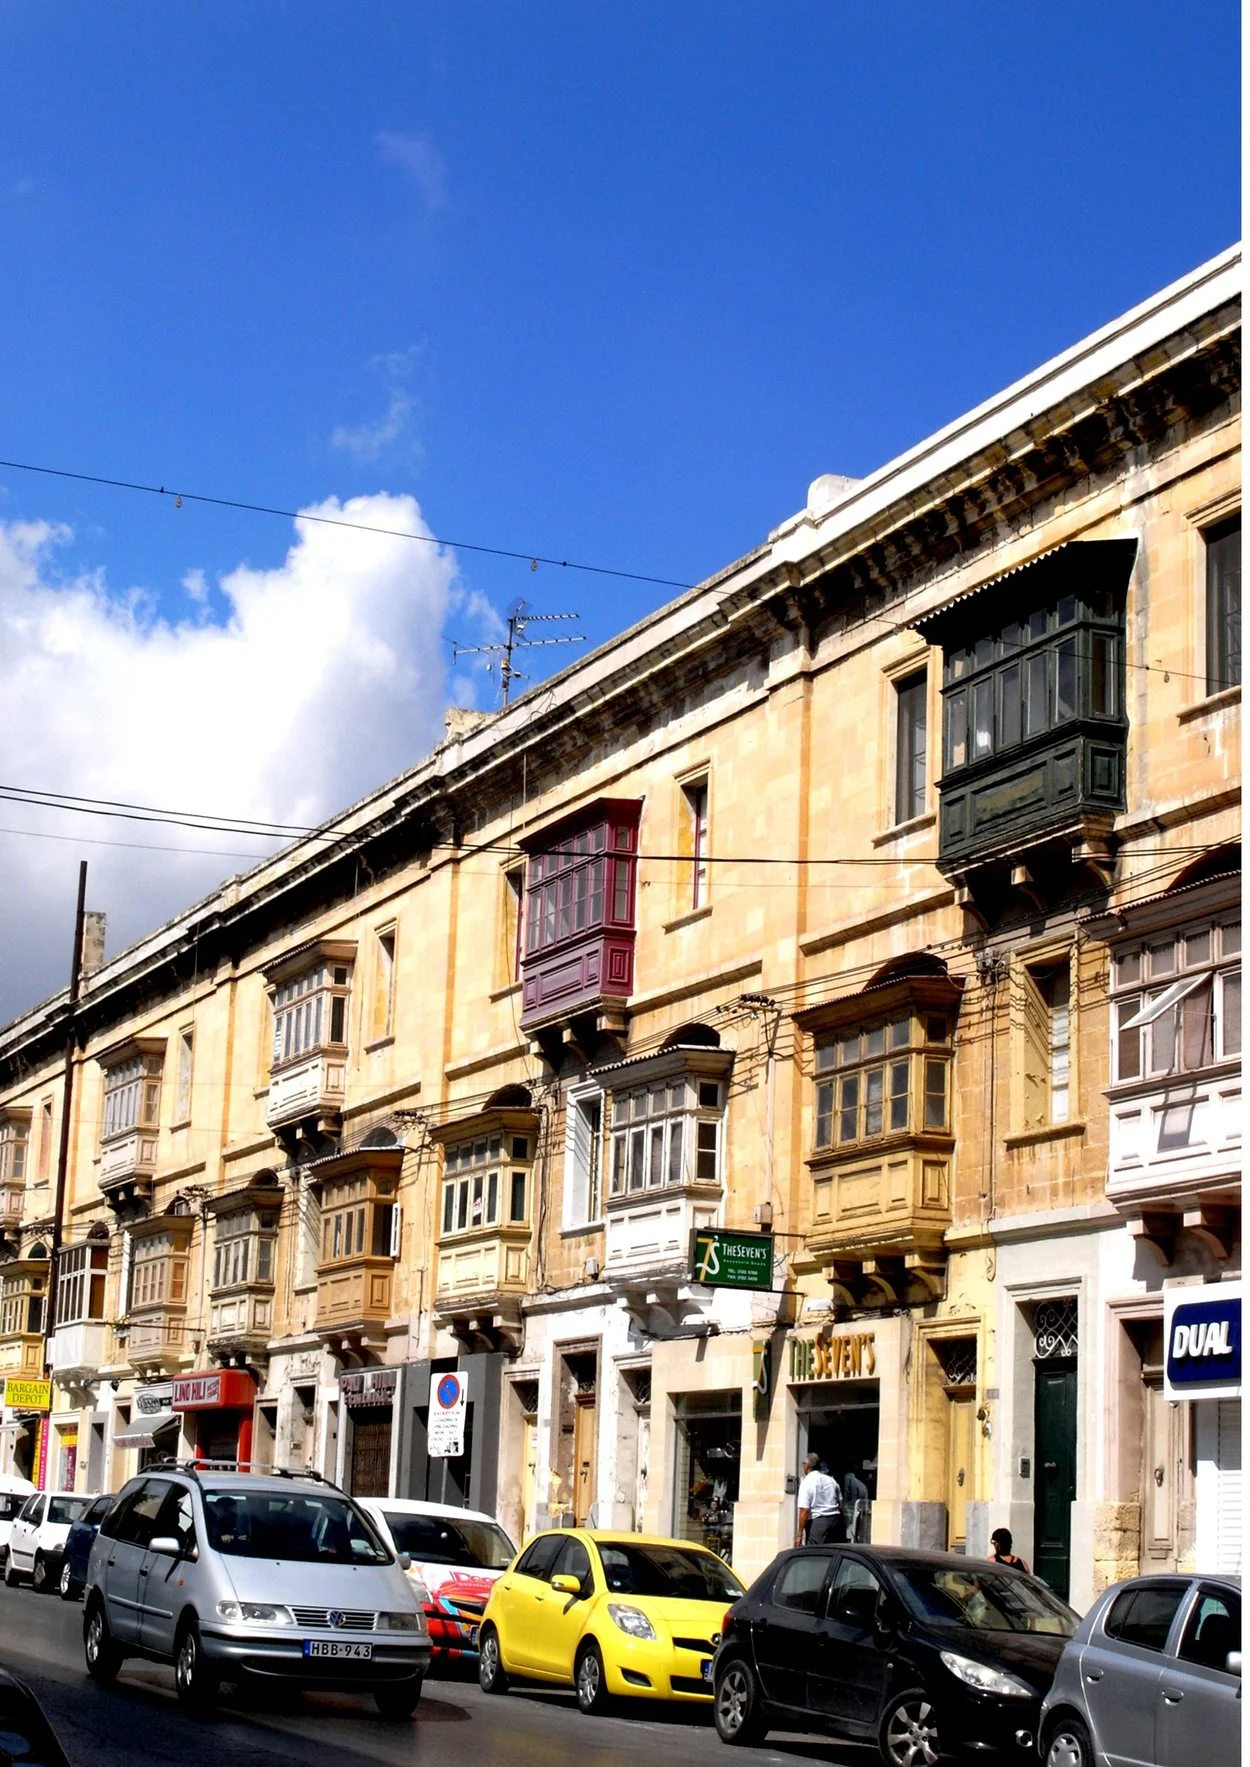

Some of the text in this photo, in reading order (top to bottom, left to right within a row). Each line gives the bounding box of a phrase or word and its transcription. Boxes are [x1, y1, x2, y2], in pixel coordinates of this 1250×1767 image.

[1172, 1321, 1233, 1358] DUAL
[7, 1382, 49, 1394] BARGAIN
[12, 1393, 43, 1404] DEPOT
